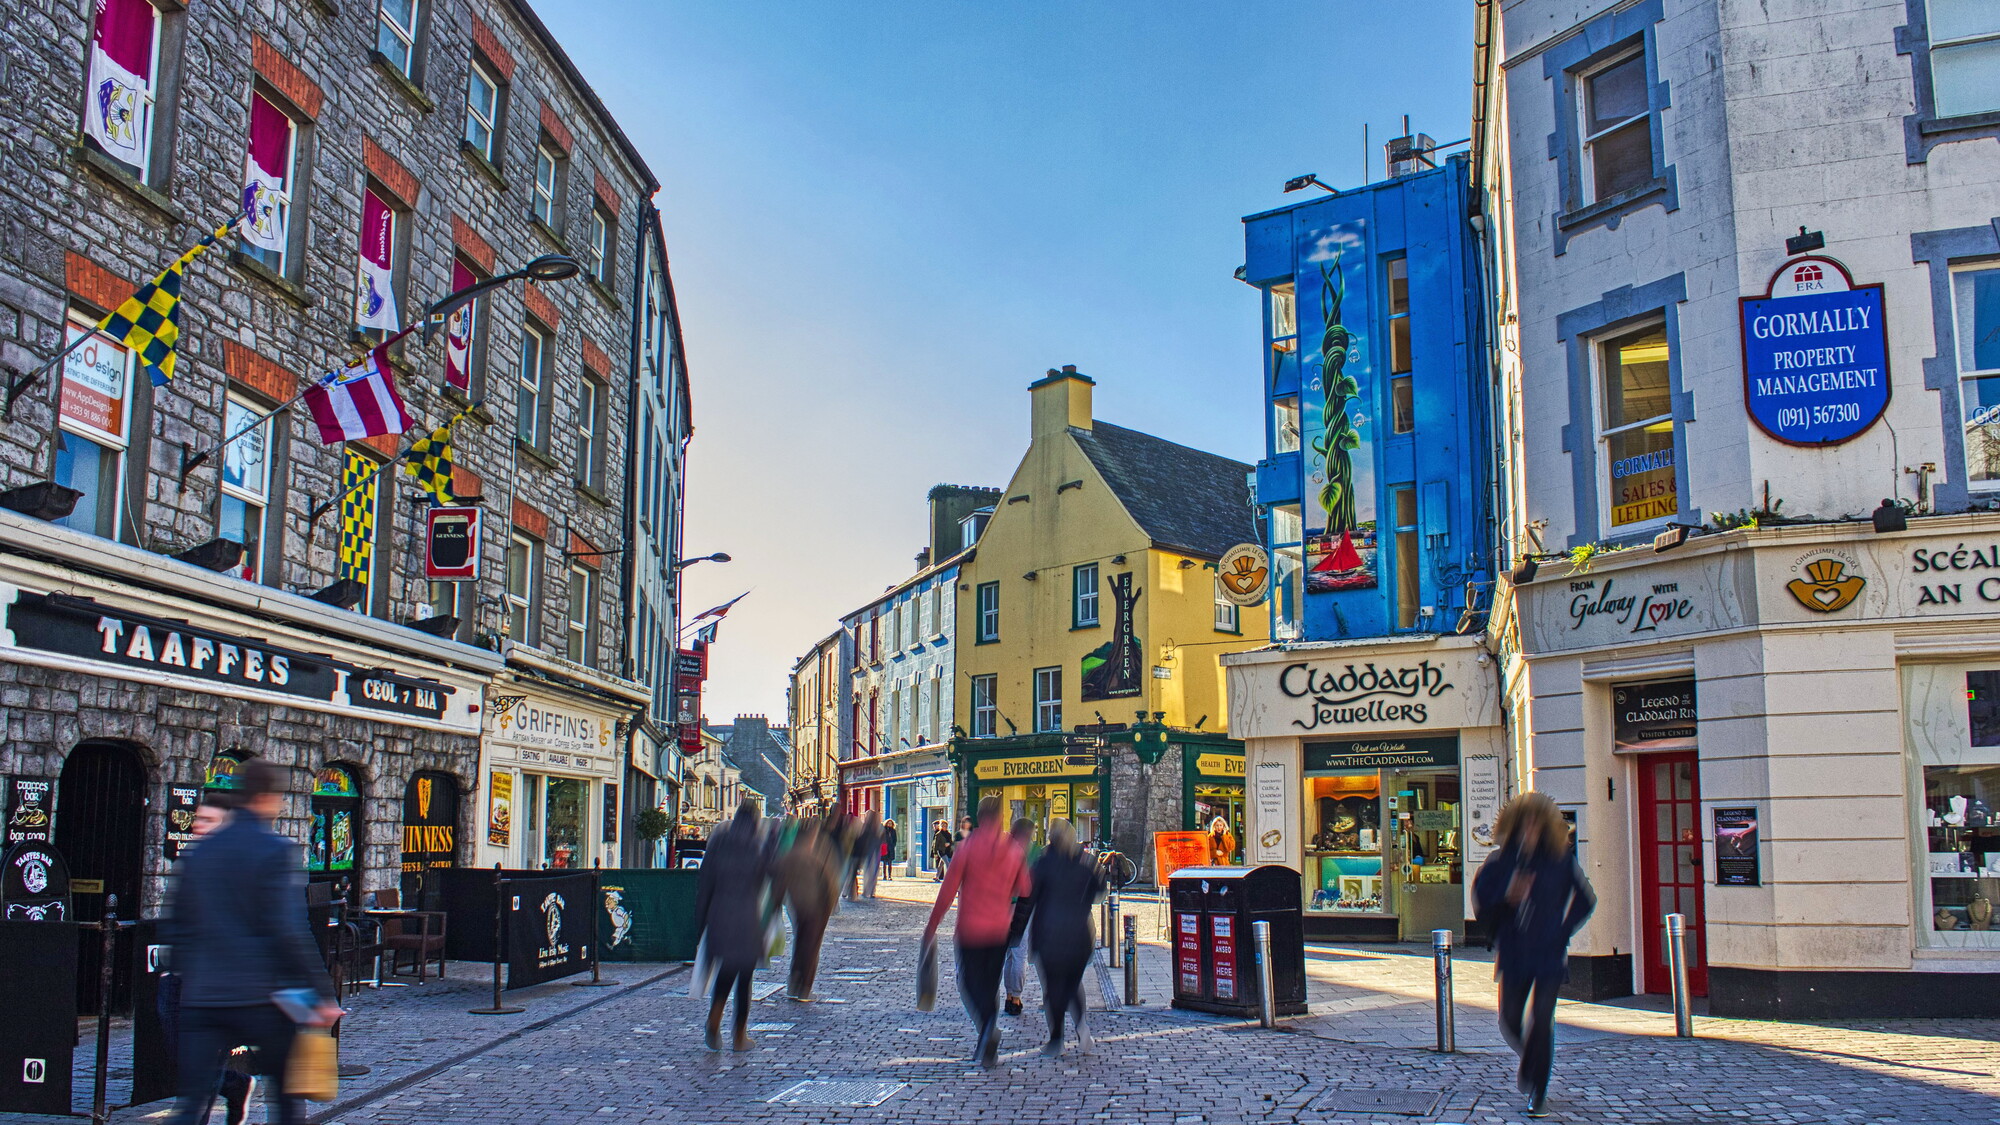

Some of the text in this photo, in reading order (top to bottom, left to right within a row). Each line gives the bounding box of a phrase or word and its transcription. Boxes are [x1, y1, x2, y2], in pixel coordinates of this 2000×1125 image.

[1753, 305, 1871, 339] GORMALLY
[1773, 345, 1856, 370] PROPERTY
[1756, 368, 1878, 397] MANAGEMENT
[1777, 402, 1860, 432] (091) 567300
[1613, 448, 1675, 479] GORMALL
[1622, 480, 1665, 504] SALES
[1617, 497, 1677, 524] LETTING
[1837, 550, 1846, 558] LE
[1569, 580, 1678, 595] FROM WITH
[1569, 578, 1636, 630] Galway
[98, 616, 290, 686] TAAFFES
[362, 678, 398, 705] CEOL
[415, 690, 438, 711] BIA
[1279, 659, 1455, 706] Claddagh
[516, 702, 589, 741] GRIFFIN'S
[1641, 730, 1666, 738] VISITOR
[522, 750, 540, 761] SEATING
[1003, 758, 1064, 776] EVERGREEN
[1200, 760, 1221, 768] HEALTH
[401, 825, 453, 853] UINNESS
[15, 851, 53, 868] TAAFFES BAR
[1182, 941, 1198, 951] ANSEO
[1215, 945, 1232, 954] ANSEO
[1182, 962, 1198, 972] HERE
[1216, 966, 1233, 977] HERE
